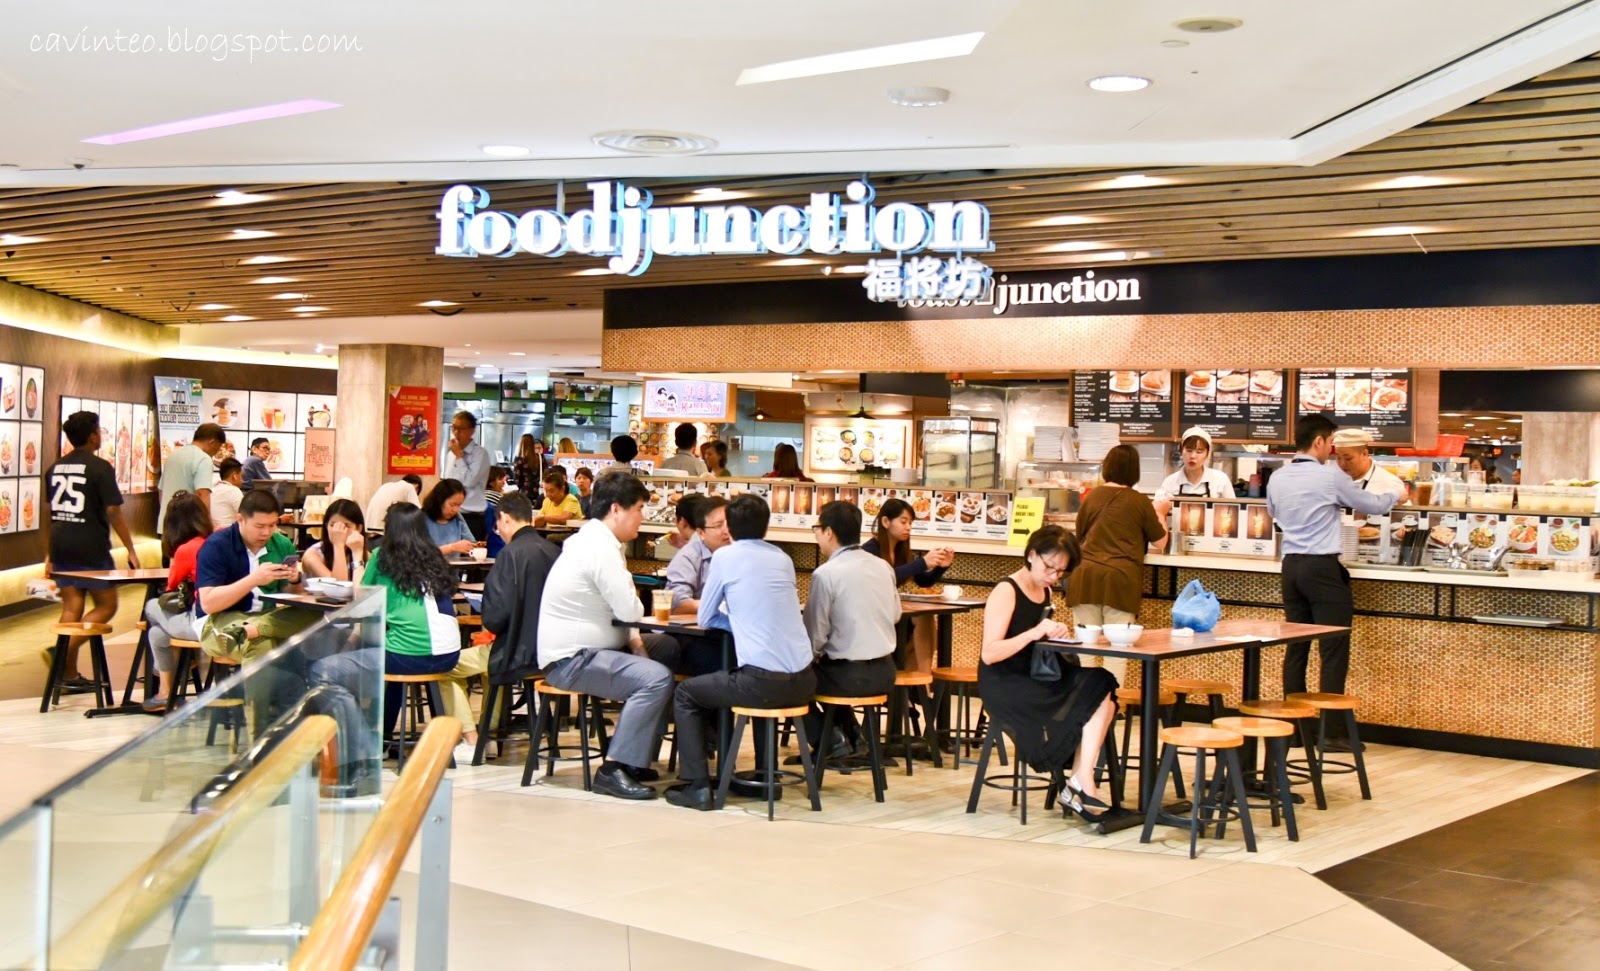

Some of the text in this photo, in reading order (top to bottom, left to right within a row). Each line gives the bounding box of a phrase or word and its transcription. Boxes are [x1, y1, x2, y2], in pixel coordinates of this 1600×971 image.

[435, 180, 996, 277] foodjunction
[862, 256, 988, 301] 福将坊
[993, 270, 1141, 314] junction
[51, 475, 87, 514] 25
